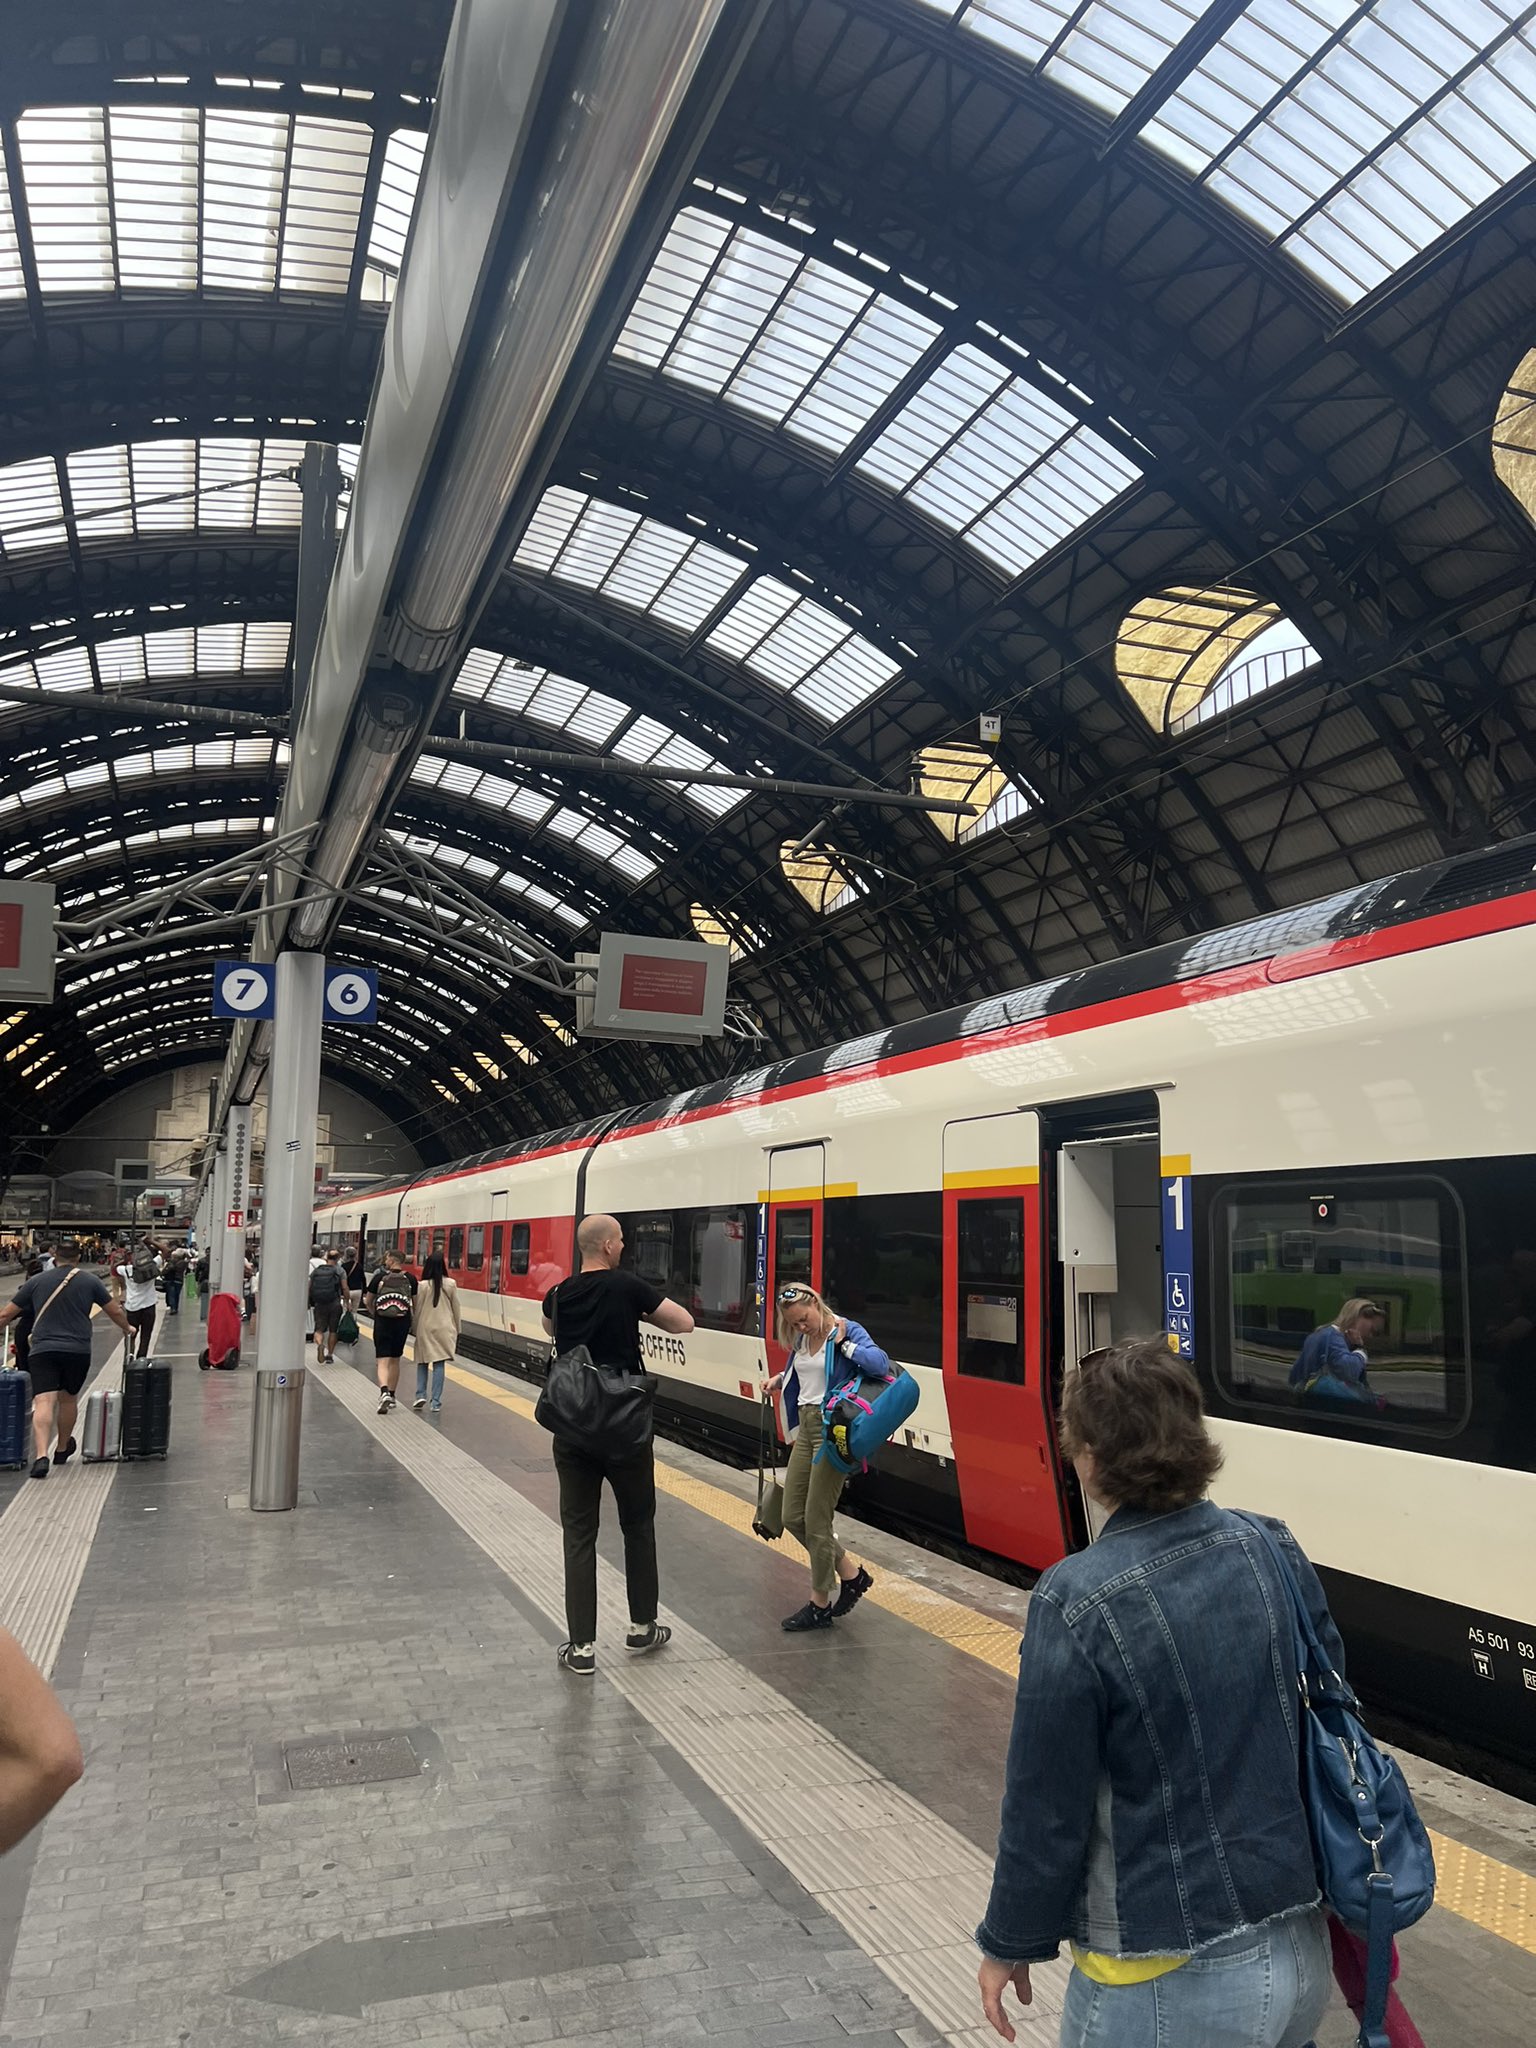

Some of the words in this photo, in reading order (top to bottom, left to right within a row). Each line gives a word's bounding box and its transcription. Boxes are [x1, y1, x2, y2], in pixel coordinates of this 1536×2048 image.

[235, 978, 256, 1000] 7
[340, 983, 359, 1005] 6
[759, 1203, 765, 1234] 1
[1168, 1176, 1184, 1231] 1
[646, 1333, 664, 1360] CFF
[665, 1337, 686, 1366] FFS
[1468, 1626, 1485, 1644] A5
[1487, 1632, 1510, 1652] 501
[1517, 1641, 1535, 1660] 93
[1478, 1661, 1489, 1675] H
